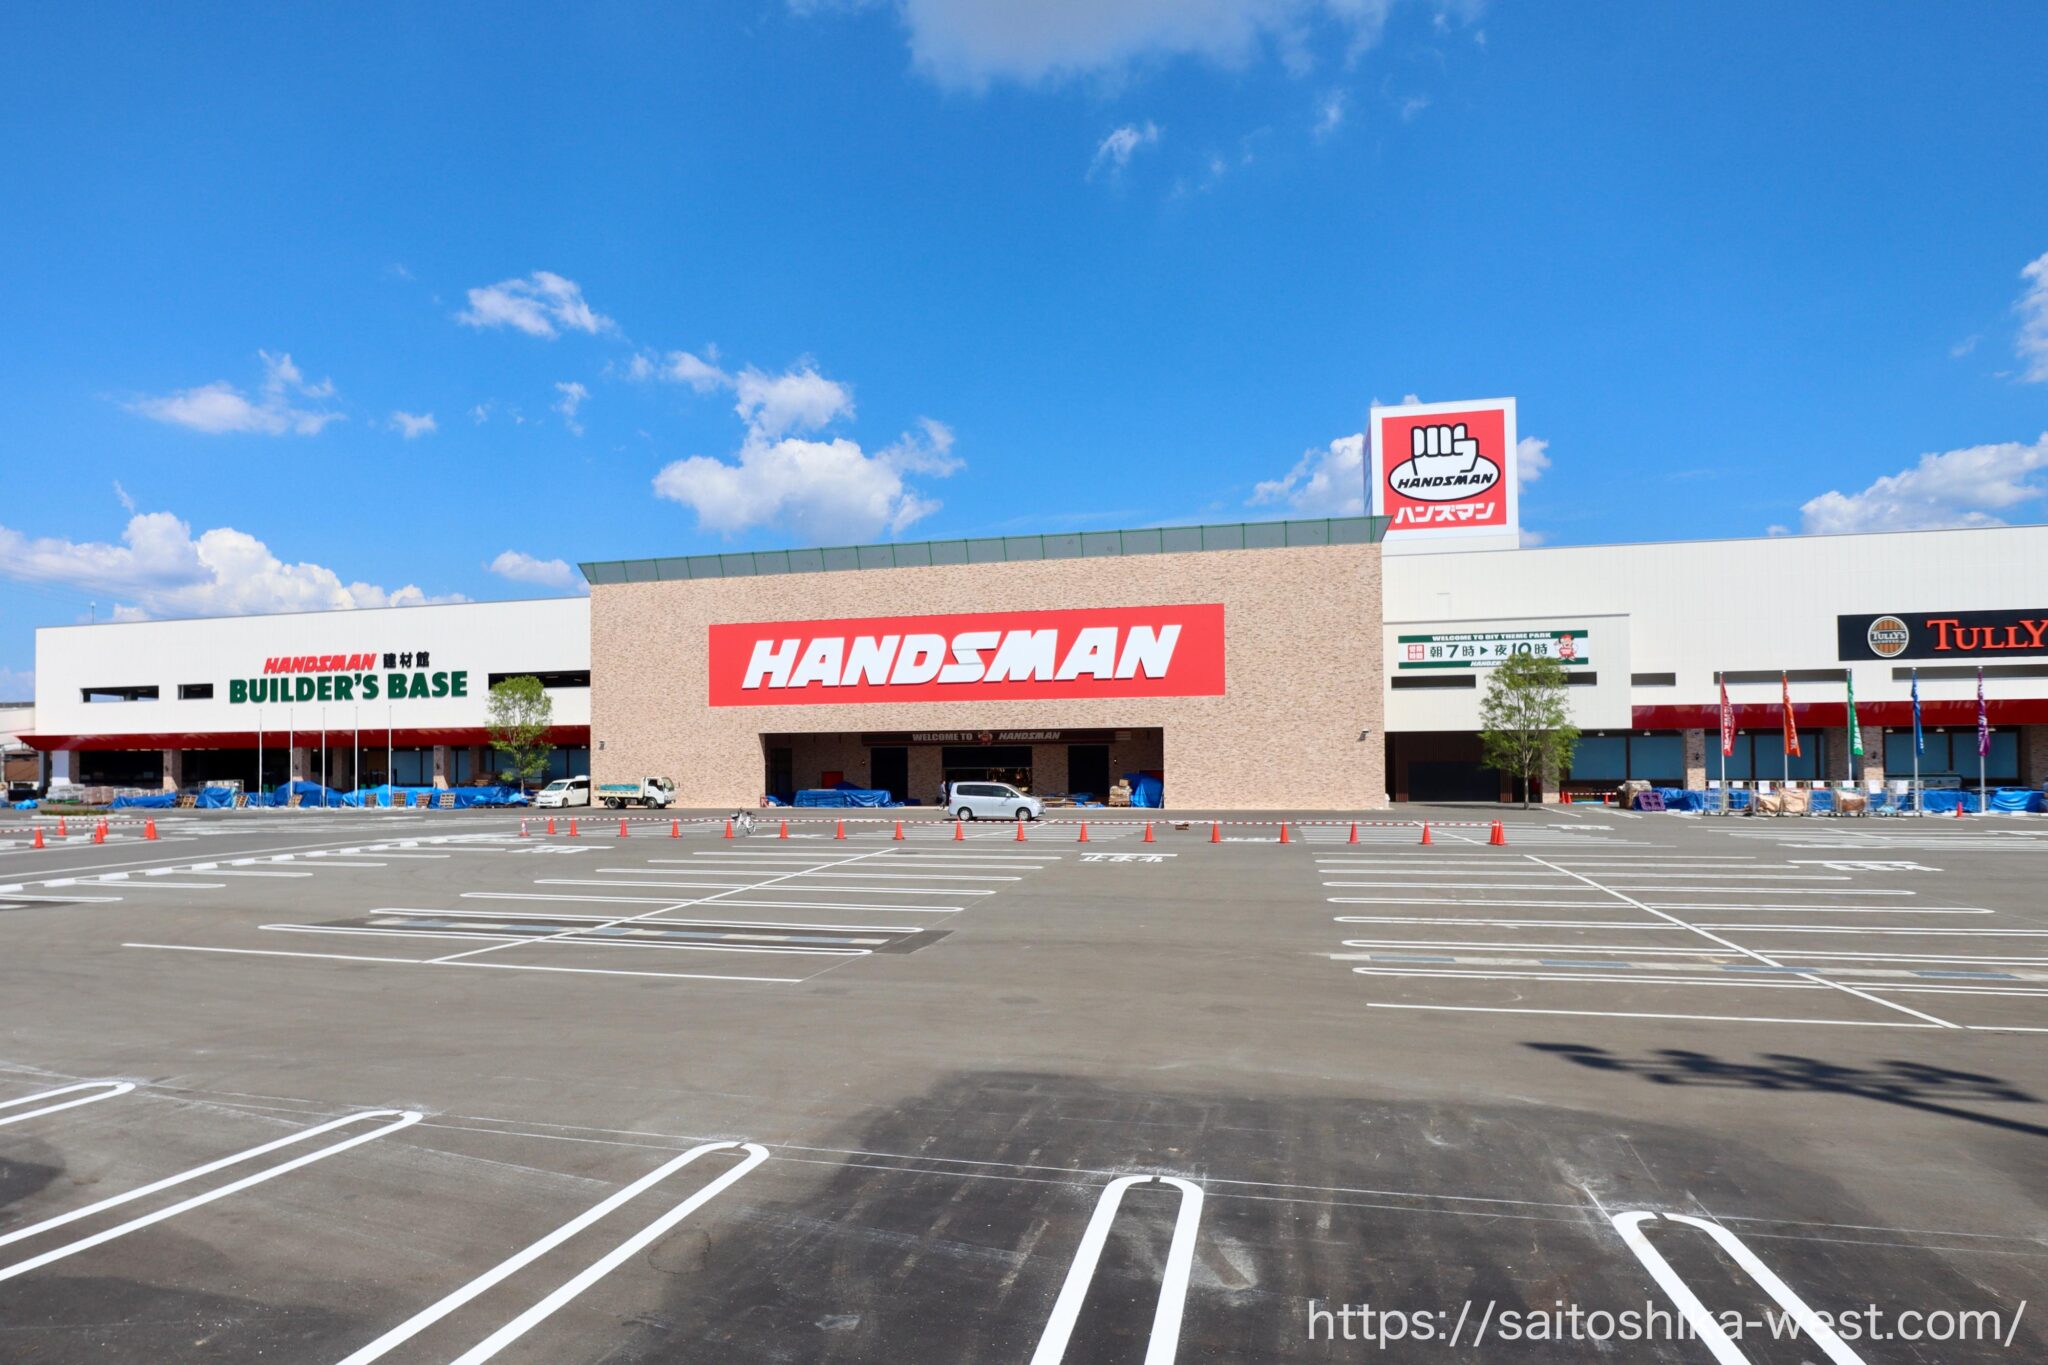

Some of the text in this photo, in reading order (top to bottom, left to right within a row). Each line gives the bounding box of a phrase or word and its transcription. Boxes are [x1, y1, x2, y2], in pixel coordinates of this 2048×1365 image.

[1397, 473, 1493, 489] HANDSMAN
[1394, 502, 1496, 524] ハンズマン
[1473, 633, 1484, 641] TO
[1501, 632, 1528, 640] THEME
[1926, 618, 2048, 650] TULLY
[263, 651, 430, 674] HANDSMAN 建材館
[741, 624, 1183, 691] HANDSMAN
[229, 671, 468, 704] BUILDER'S BASE
[912, 731, 1060, 741] WELCOME TO HANDSMAN
